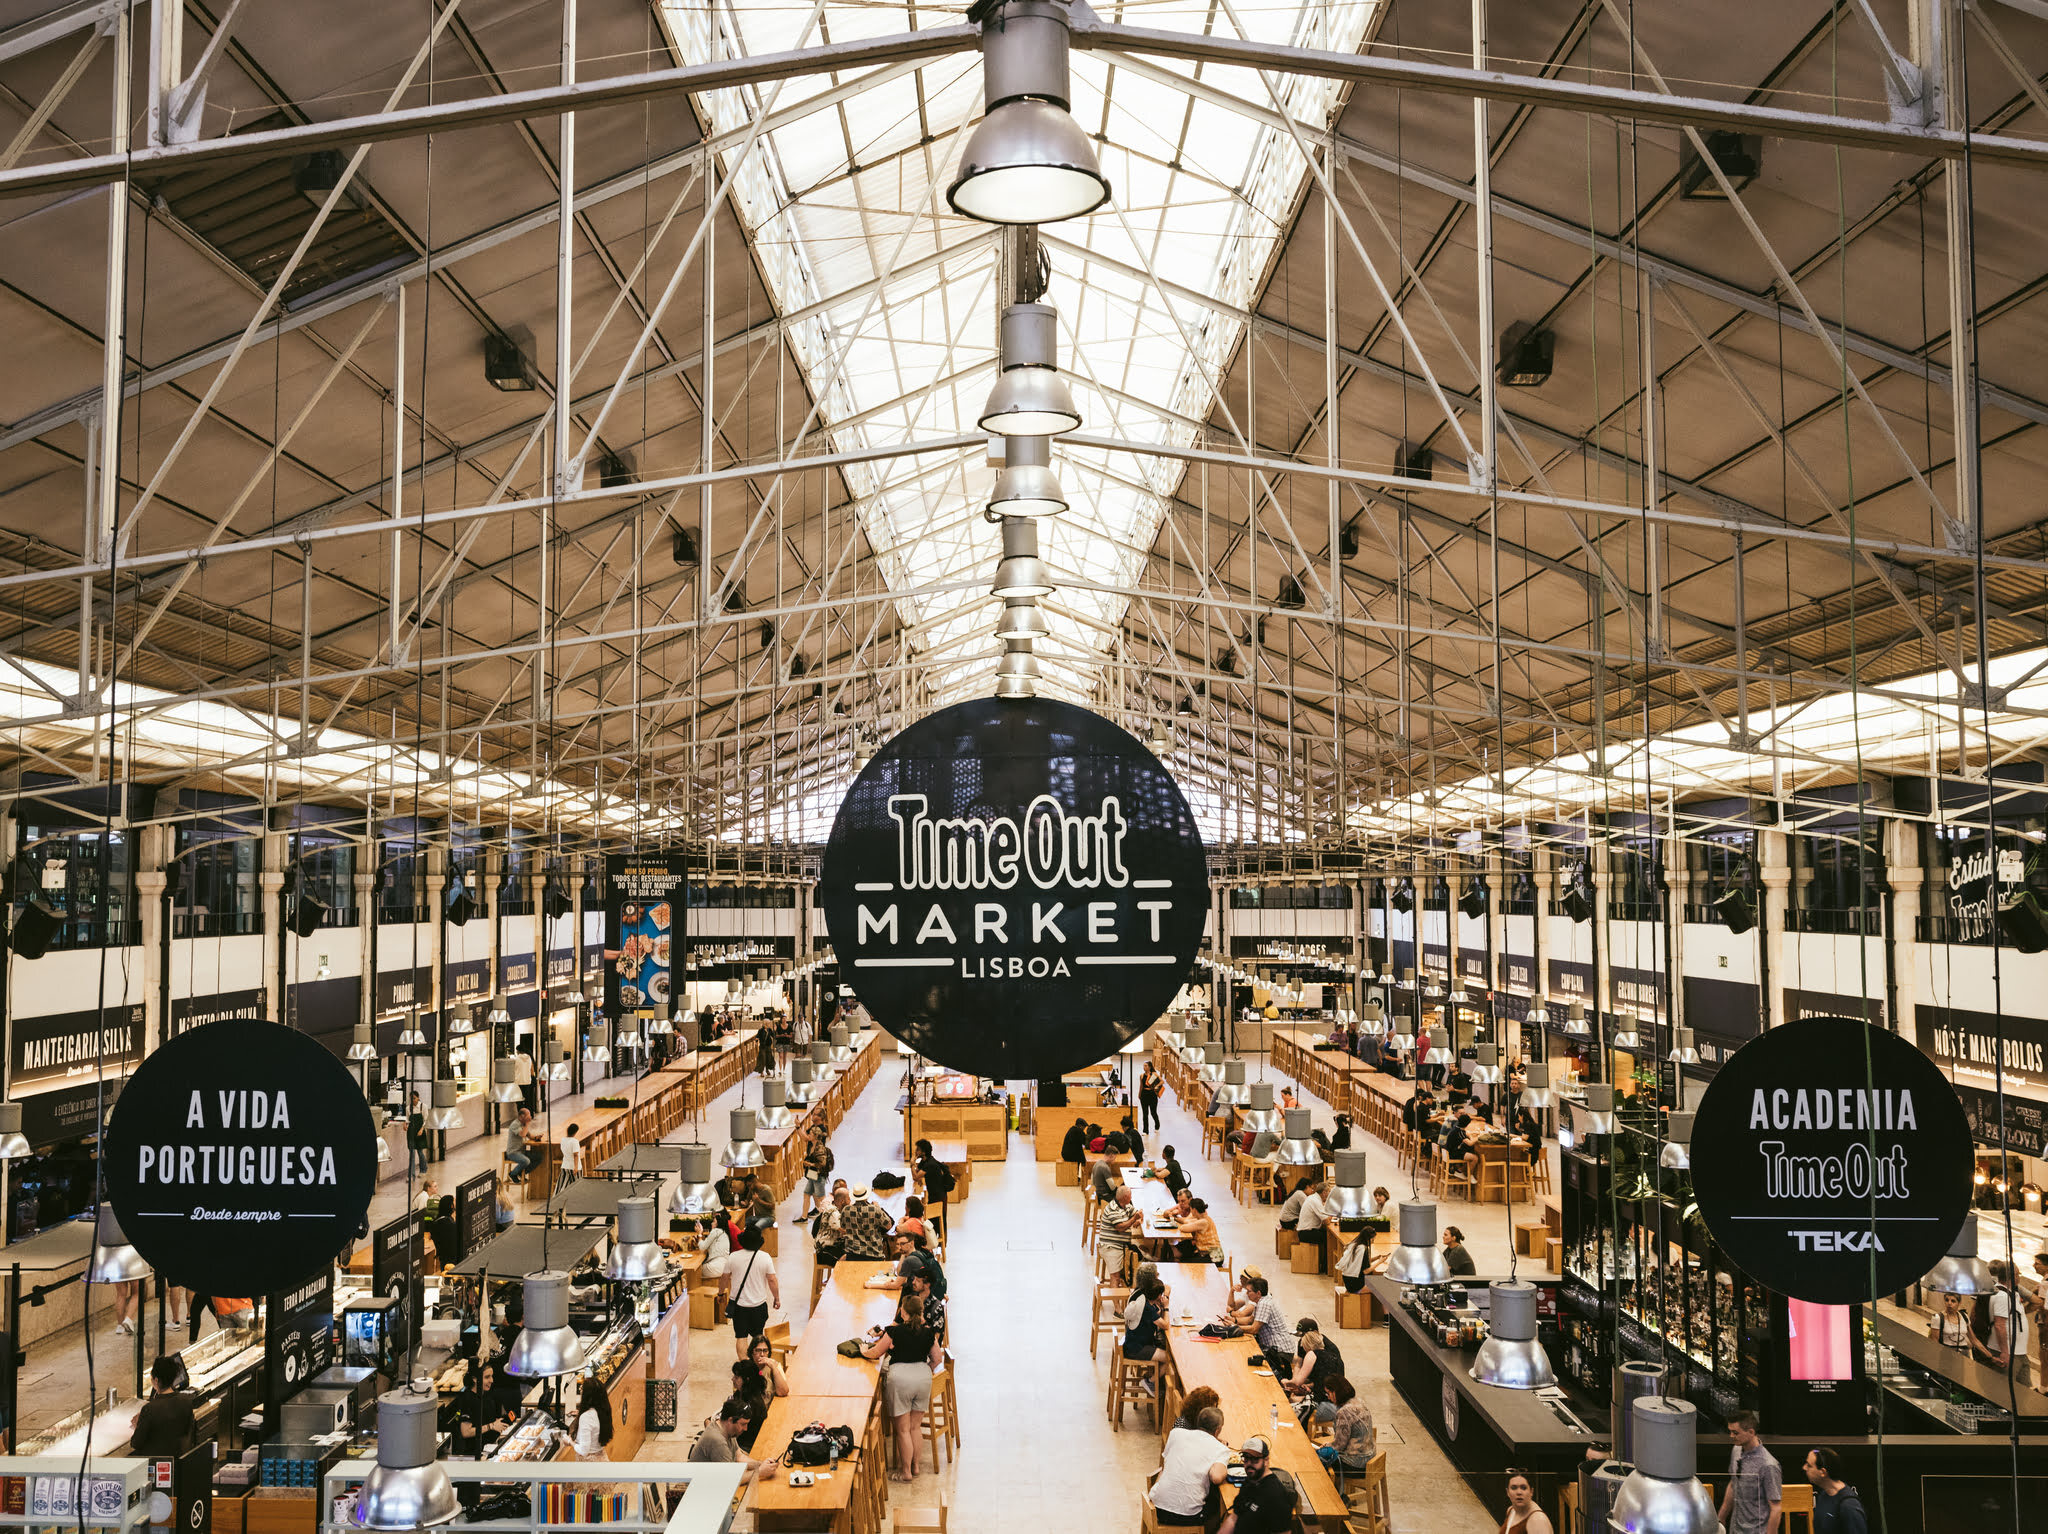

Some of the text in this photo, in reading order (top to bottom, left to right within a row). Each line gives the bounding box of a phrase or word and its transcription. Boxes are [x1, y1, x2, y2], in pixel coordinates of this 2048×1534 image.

[612, 874, 630, 882] TODOS
[640, 874, 682, 882] RESTAURANTES
[857, 901, 1173, 945] MARKET
[694, 944, 726, 956] SUSAA
[962, 957, 1071, 978] LISBOA
[24, 1026, 132, 1070] MANTEIGARIA SILVA
[1934, 1024, 2043, 1072] NÓS É MAIS BOLOS
[186, 1090, 291, 1129] A VIDA
[1750, 1088, 1917, 1130] ACADEMIA
[138, 1145, 337, 1185] PORTUGUESA
[190, 1206, 282, 1223] Desde sempre
[1788, 1231, 1885, 1252] TEKA
[284, 1292, 298, 1312] TERRA
[299, 1288, 304, 1304] DO
